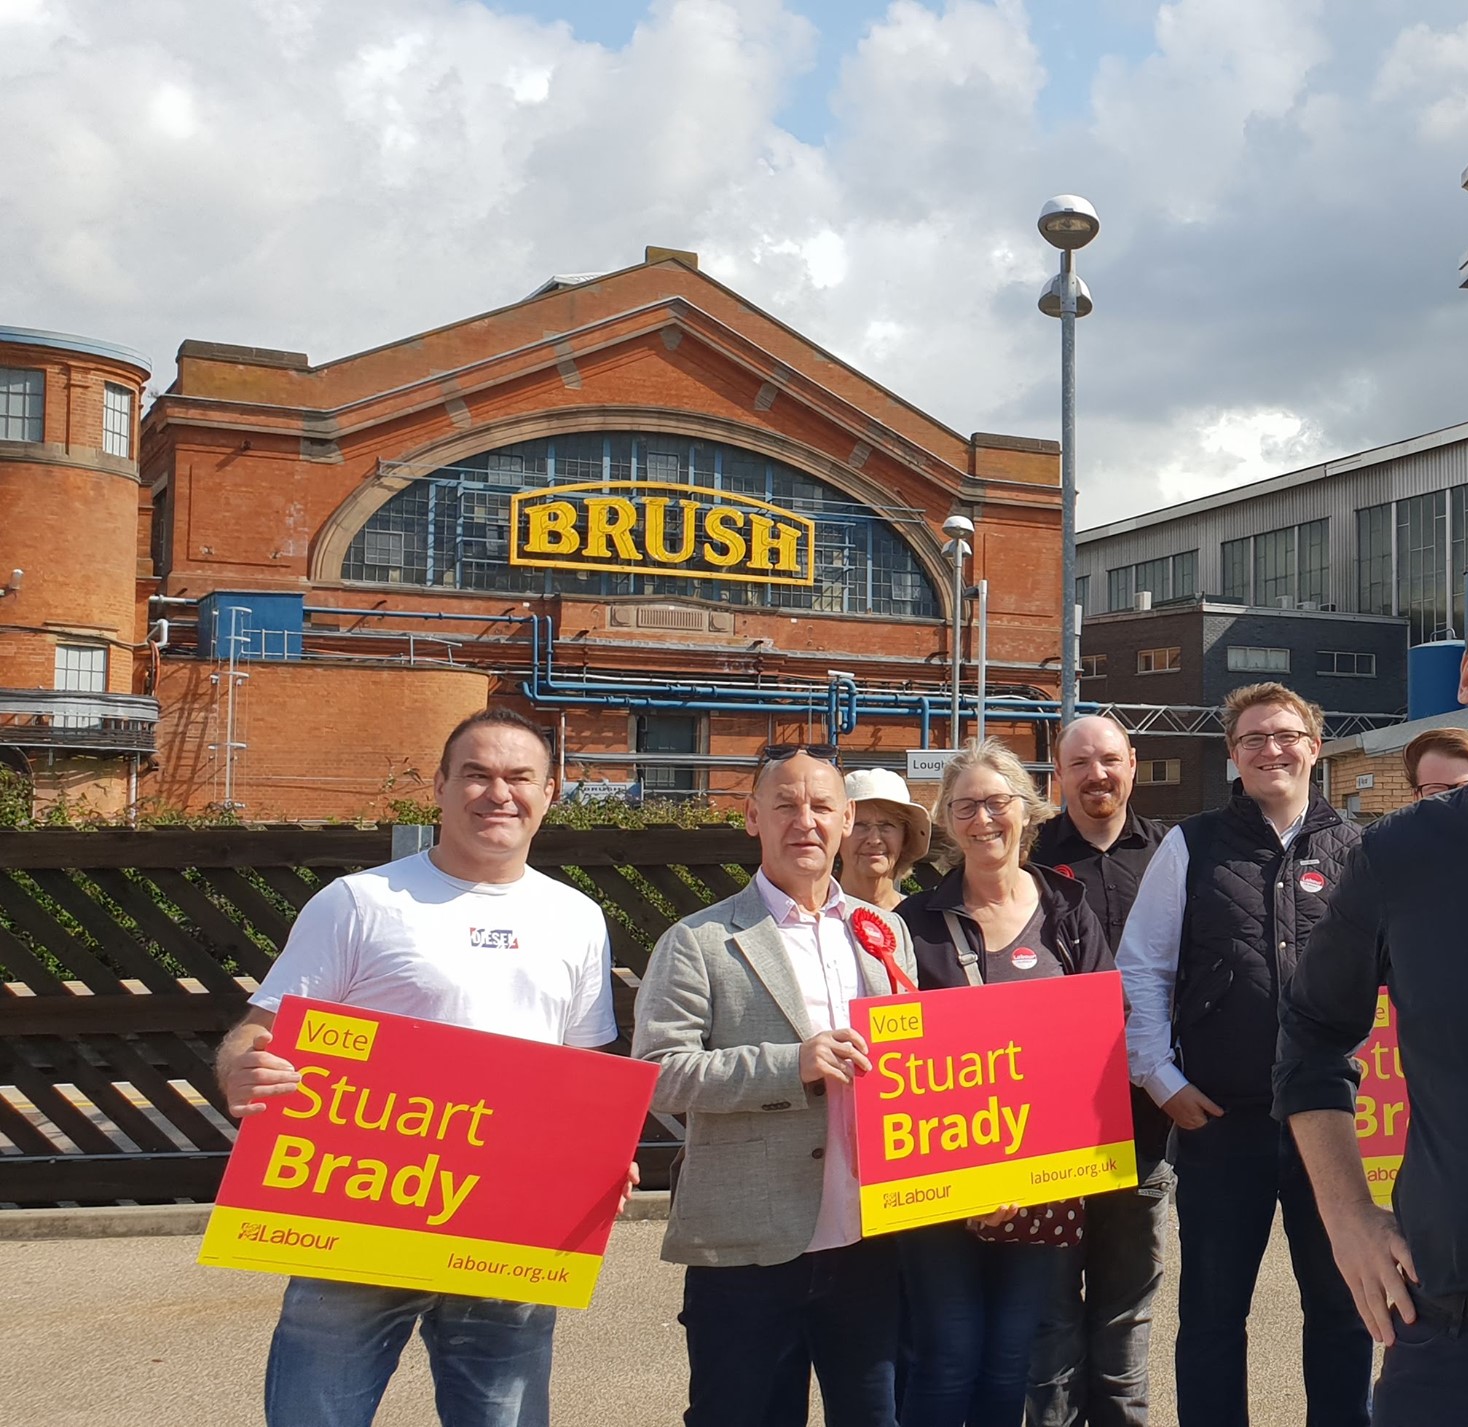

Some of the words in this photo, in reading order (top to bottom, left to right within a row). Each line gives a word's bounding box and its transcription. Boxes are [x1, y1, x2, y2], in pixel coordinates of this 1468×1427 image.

[523, 496, 802, 571] BRUSH
[307, 1020, 370, 1052] Vote
[872, 1013, 919, 1035] Vote
[877, 1040, 1024, 1100] Stuart
[282, 1065, 494, 1147] Stuart
[882, 1095, 1031, 1161] Brady
[262, 1134, 481, 1226] Brady
[1030, 1158, 1118, 1185] labour.org.uk
[896, 1185, 952, 1206] Labour
[259, 1224, 340, 1251] Labour
[447, 1252, 570, 1283] labour.org.uk
